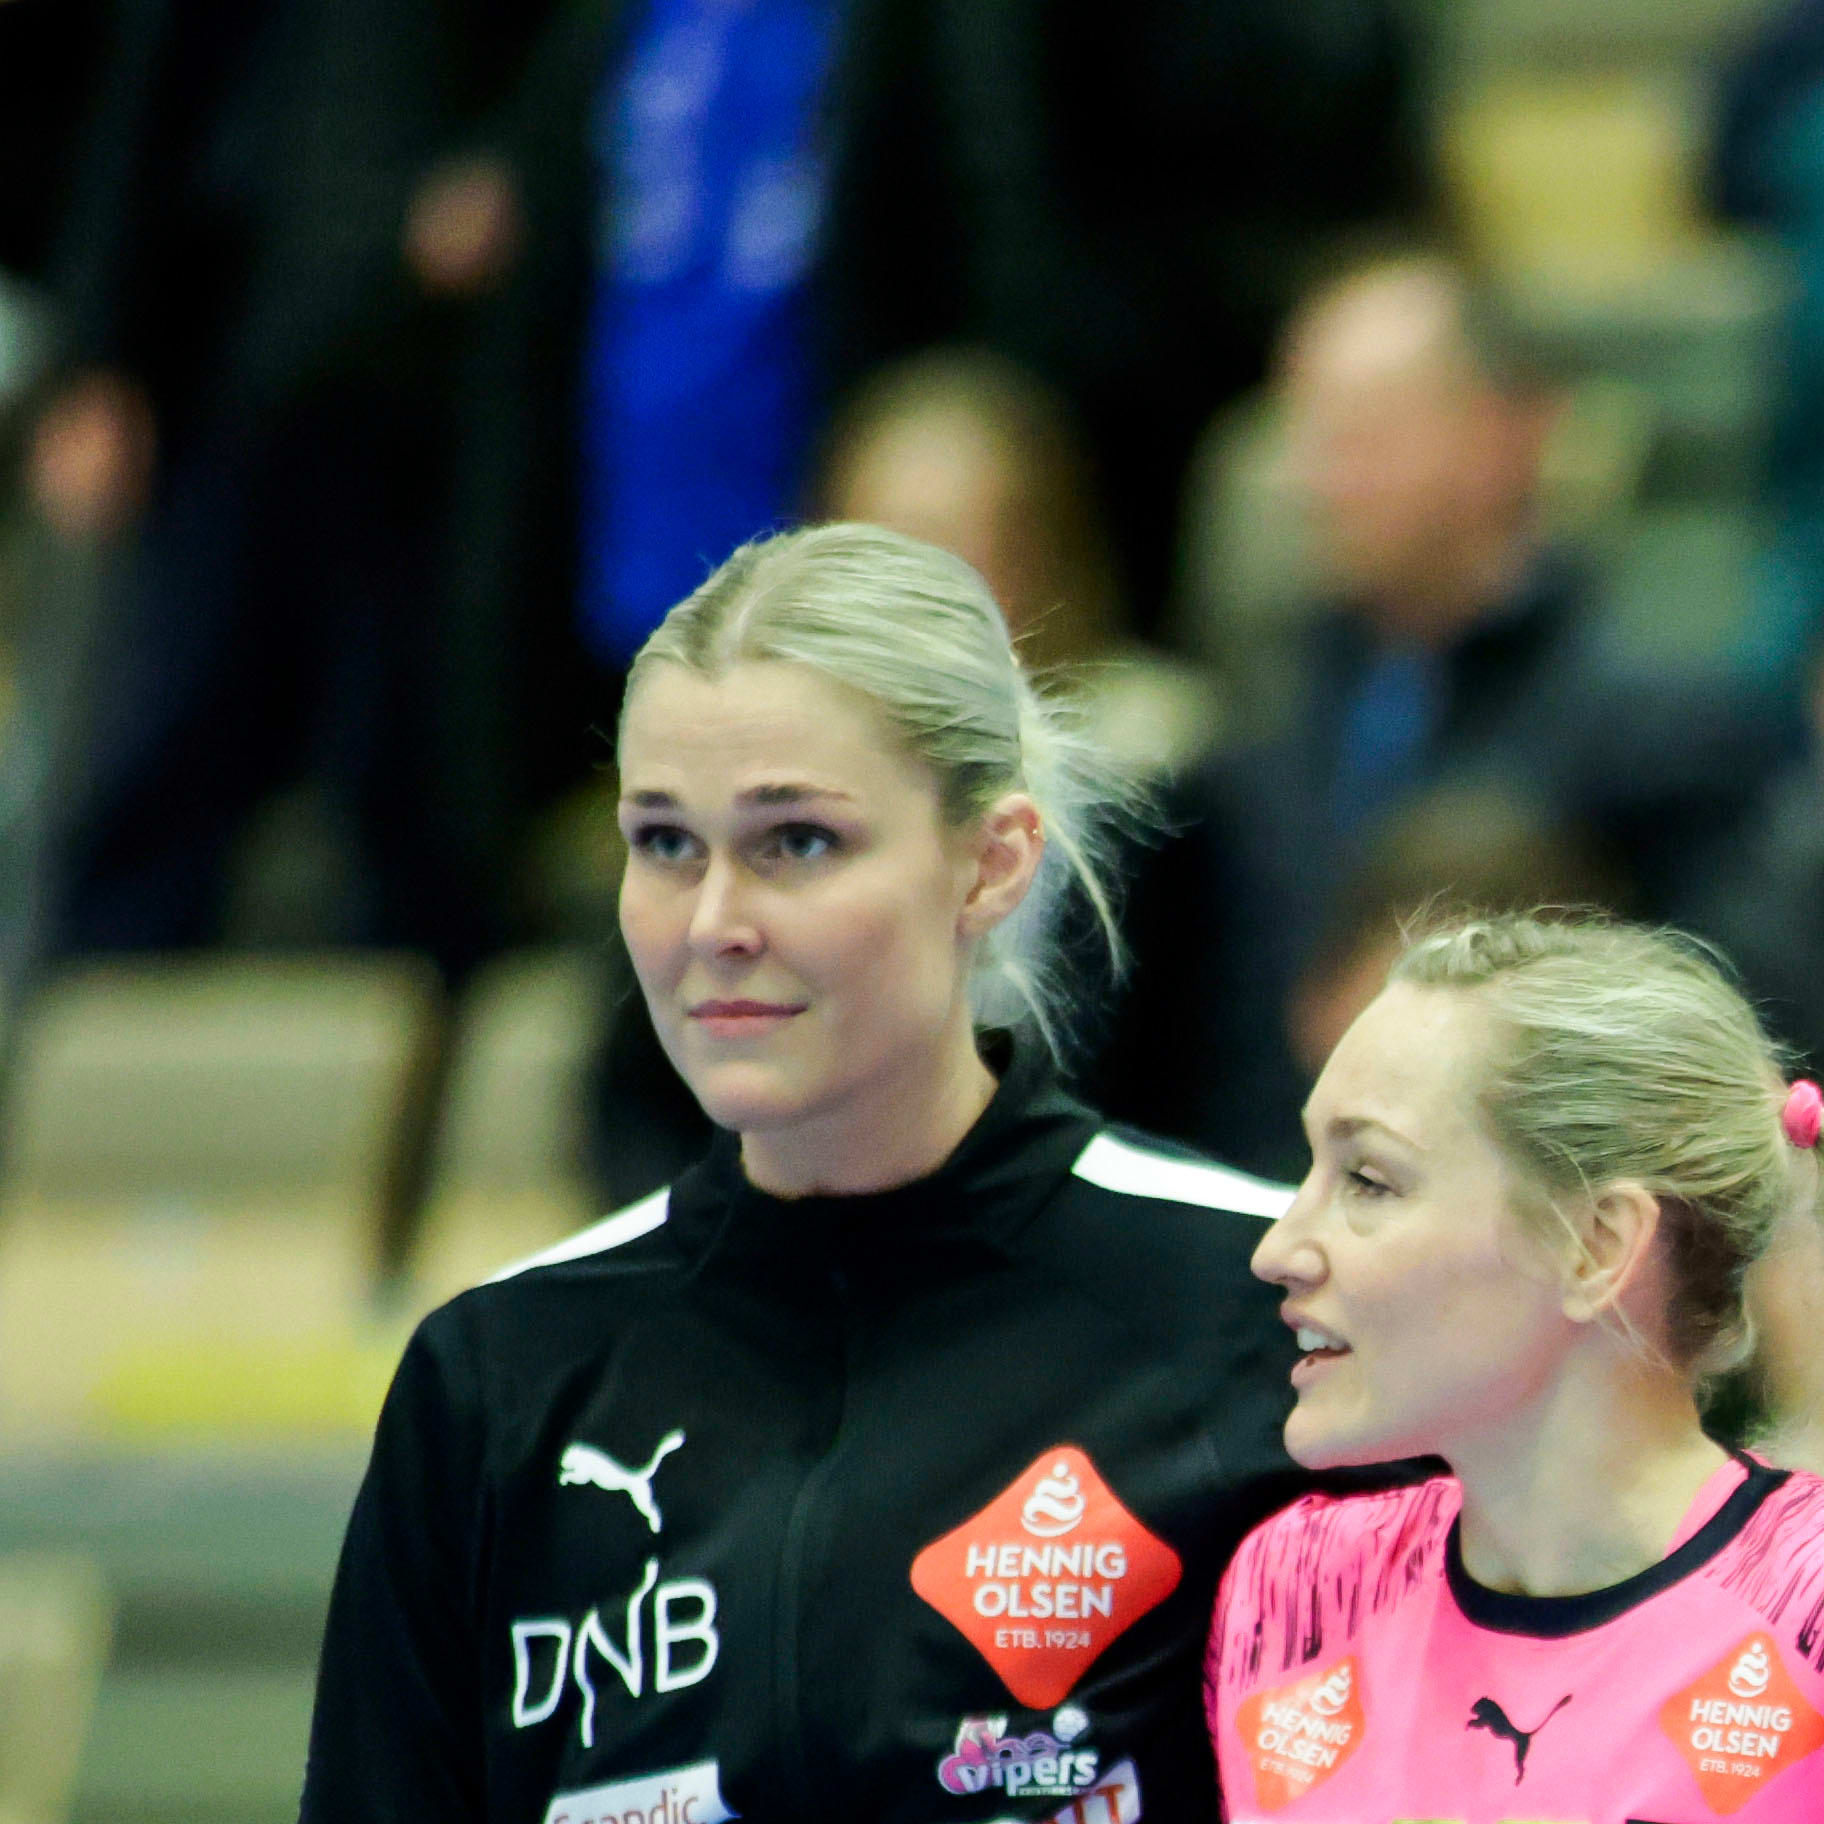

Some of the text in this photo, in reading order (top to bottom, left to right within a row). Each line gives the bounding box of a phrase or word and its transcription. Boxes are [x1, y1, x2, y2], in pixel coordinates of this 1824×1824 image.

[965, 1543, 1127, 1579] HENNIG
[973, 1582, 1114, 1618] OLSEN
[511, 1557, 719, 1748] DNB
[1689, 1698, 1793, 1732] HENNIG
[1258, 1729, 1339, 1768] OLSEN
[1691, 1727, 1781, 1758] OLSEN
